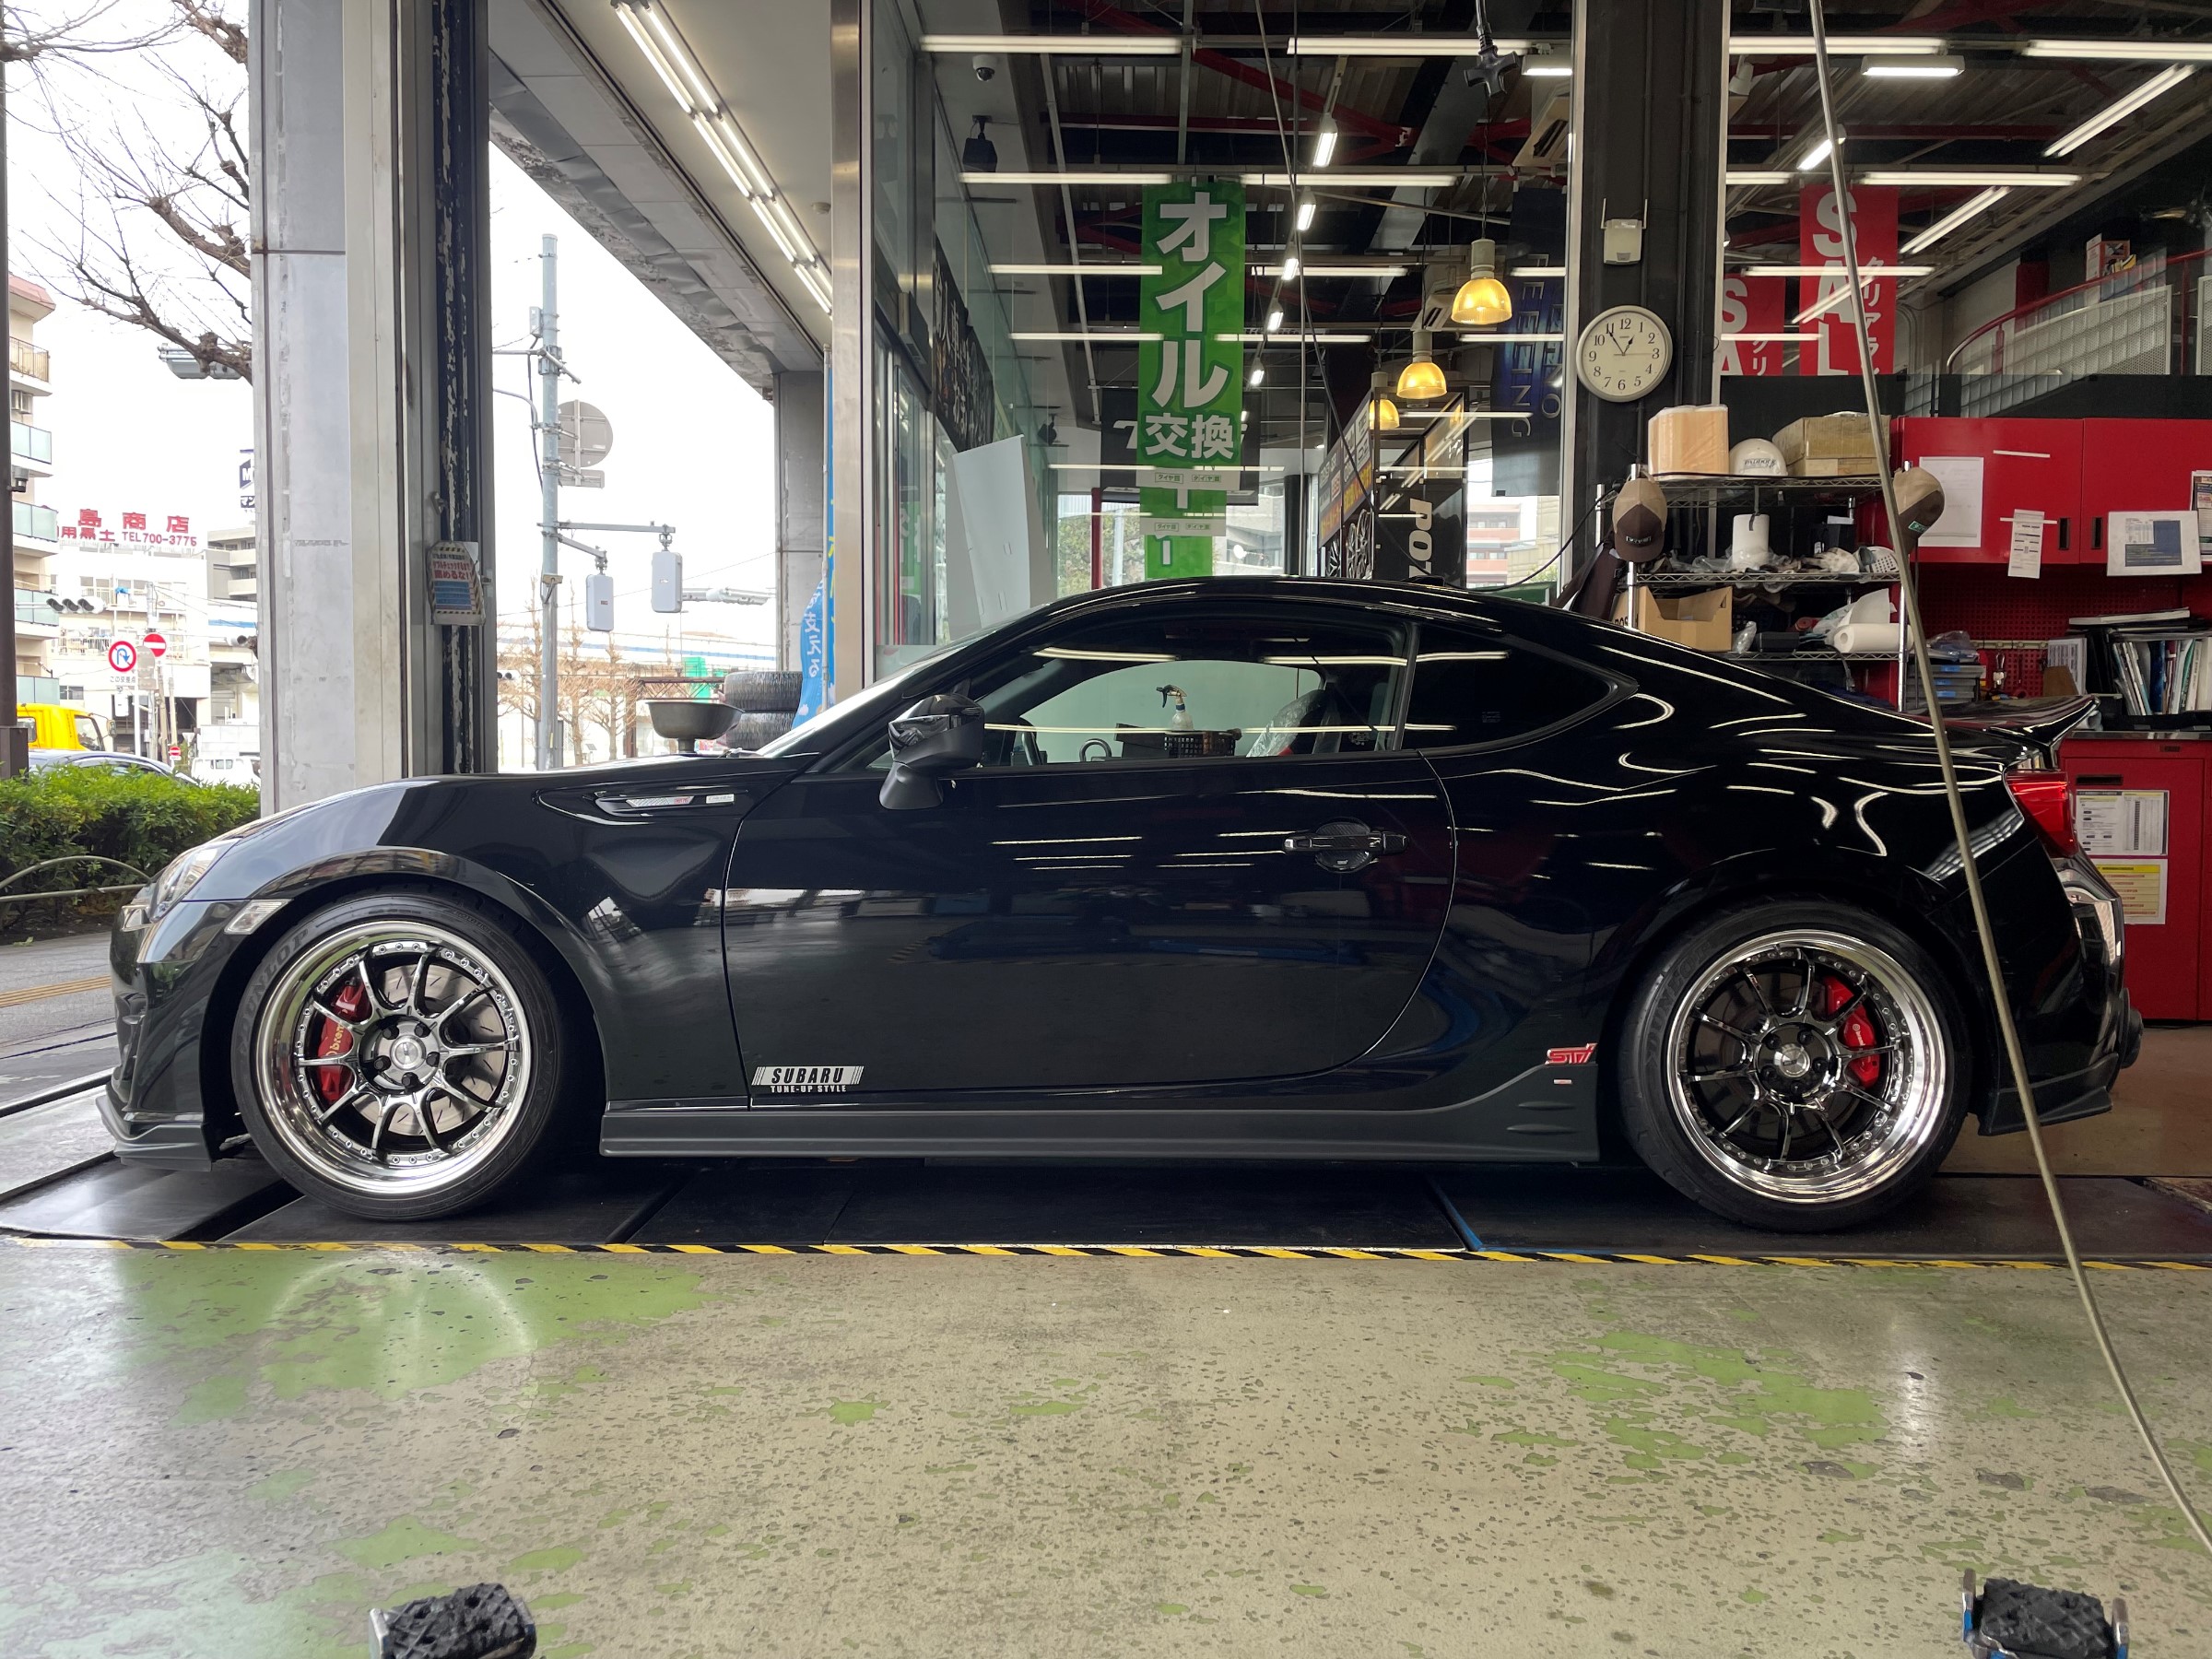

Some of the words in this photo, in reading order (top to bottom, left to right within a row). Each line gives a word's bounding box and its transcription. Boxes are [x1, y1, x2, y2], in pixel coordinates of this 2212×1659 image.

[1152, 192, 1230, 408] オイル
[1606, 323, 1615, 335] 11
[1619, 318, 1631, 330] 12
[1639, 321, 1643, 333] 1
[1594, 334, 1606, 347] 10
[1647, 332, 1655, 345] 2
[1588, 350, 1597, 362] 9
[1652, 347, 1660, 359] 3
[1593, 366, 1602, 378] 8
[1644, 363, 1653, 374] 4
[1604, 376, 1612, 388] 7
[1618, 379, 1626, 391] 6
[1633, 375, 1642, 387] 5
[1145, 412, 1234, 459] 交換
[78, 508, 190, 534] 島商店
[56, 525, 115, 543] 用黒土
[238, 928, 309, 1041] DUNLOP
[329, 1022, 346, 1052] brem
[1545, 1042, 1598, 1065] STI
[771, 1066, 845, 1085] SUBARU
[770, 1085, 814, 1094] TUNE-UP
[817, 1085, 848, 1093] STYLE
